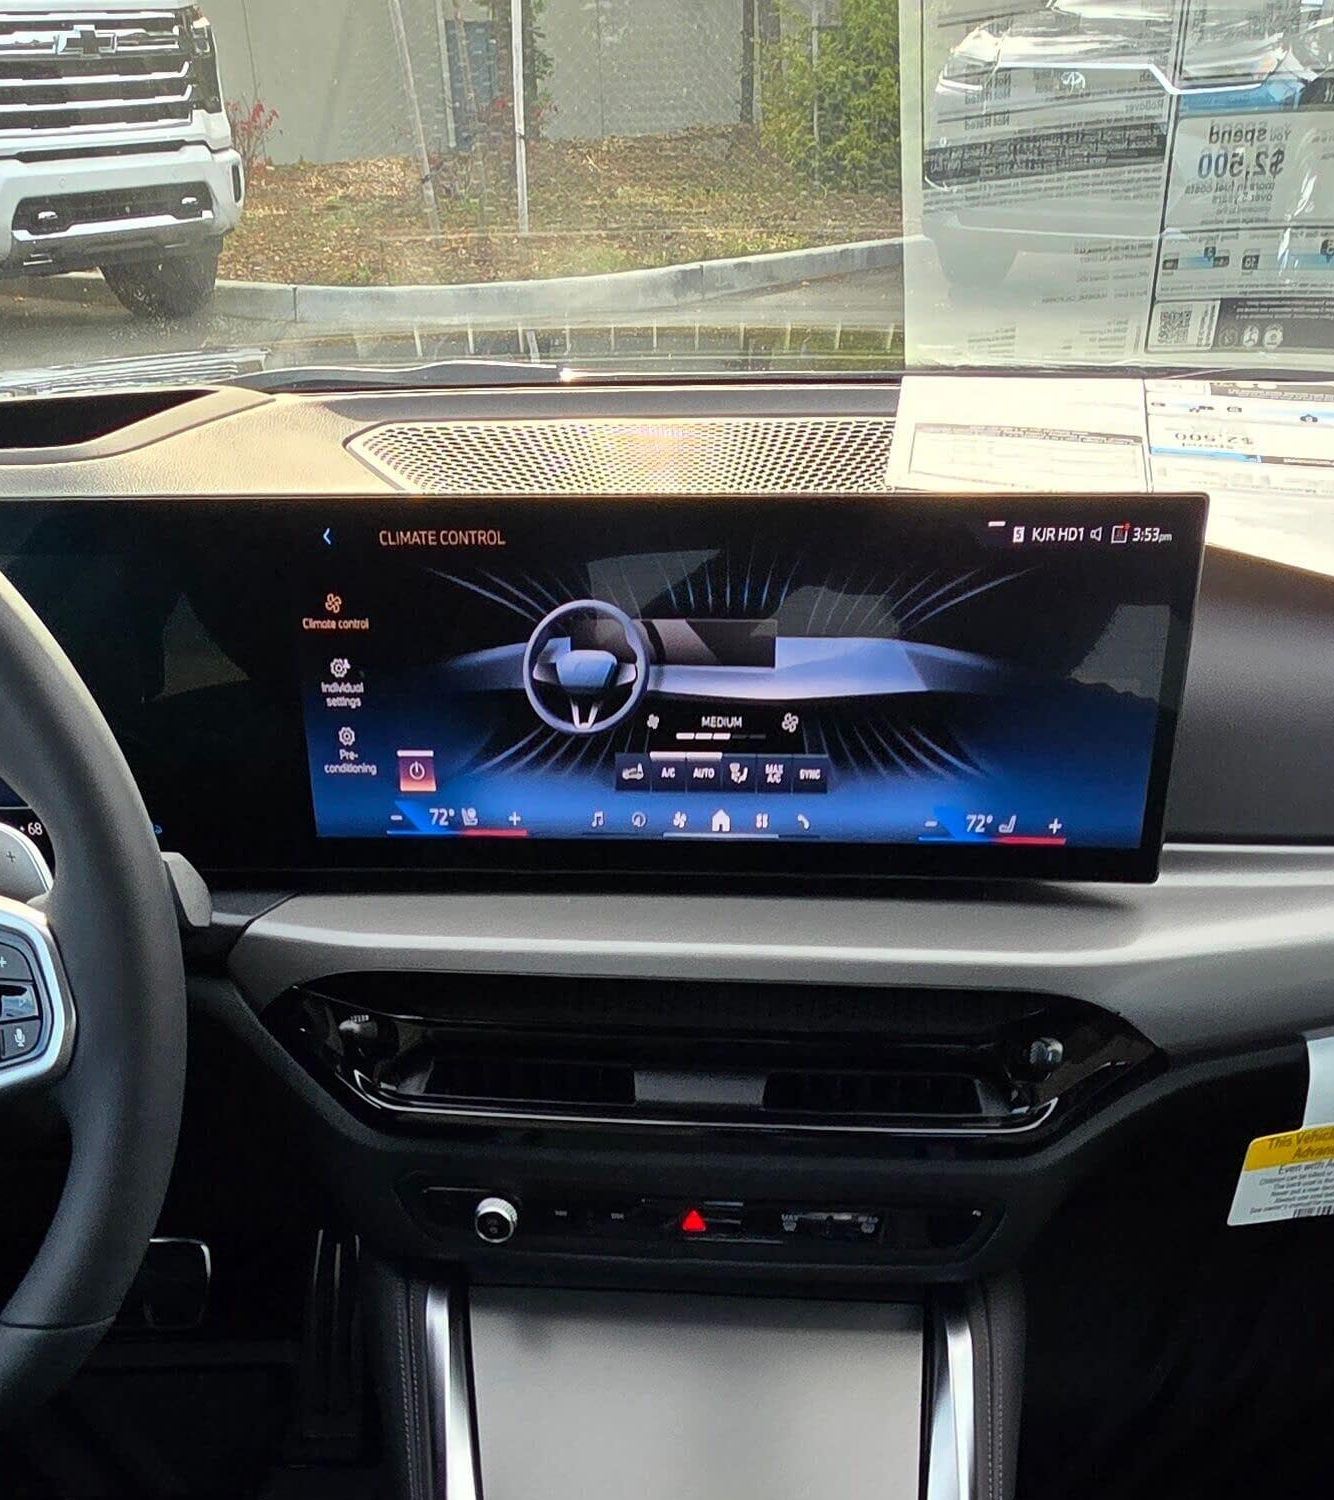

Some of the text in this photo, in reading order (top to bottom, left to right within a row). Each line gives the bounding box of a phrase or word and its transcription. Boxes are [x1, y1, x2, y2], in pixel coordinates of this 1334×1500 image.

[378, 529, 507, 546] CLIMATE CONTROL
[1031, 526, 1085, 543] KJR HD1
[302, 617, 370, 630] Climate control
[321, 681, 365, 694] Individual
[326, 696, 363, 709] settings
[701, 715, 743, 729] MEDIUM
[323, 763, 378, 776] conditioning
[692, 767, 716, 780] AUTO
[1267, 1136, 1293, 1150] This
[1278, 1164, 1303, 1175] Even
